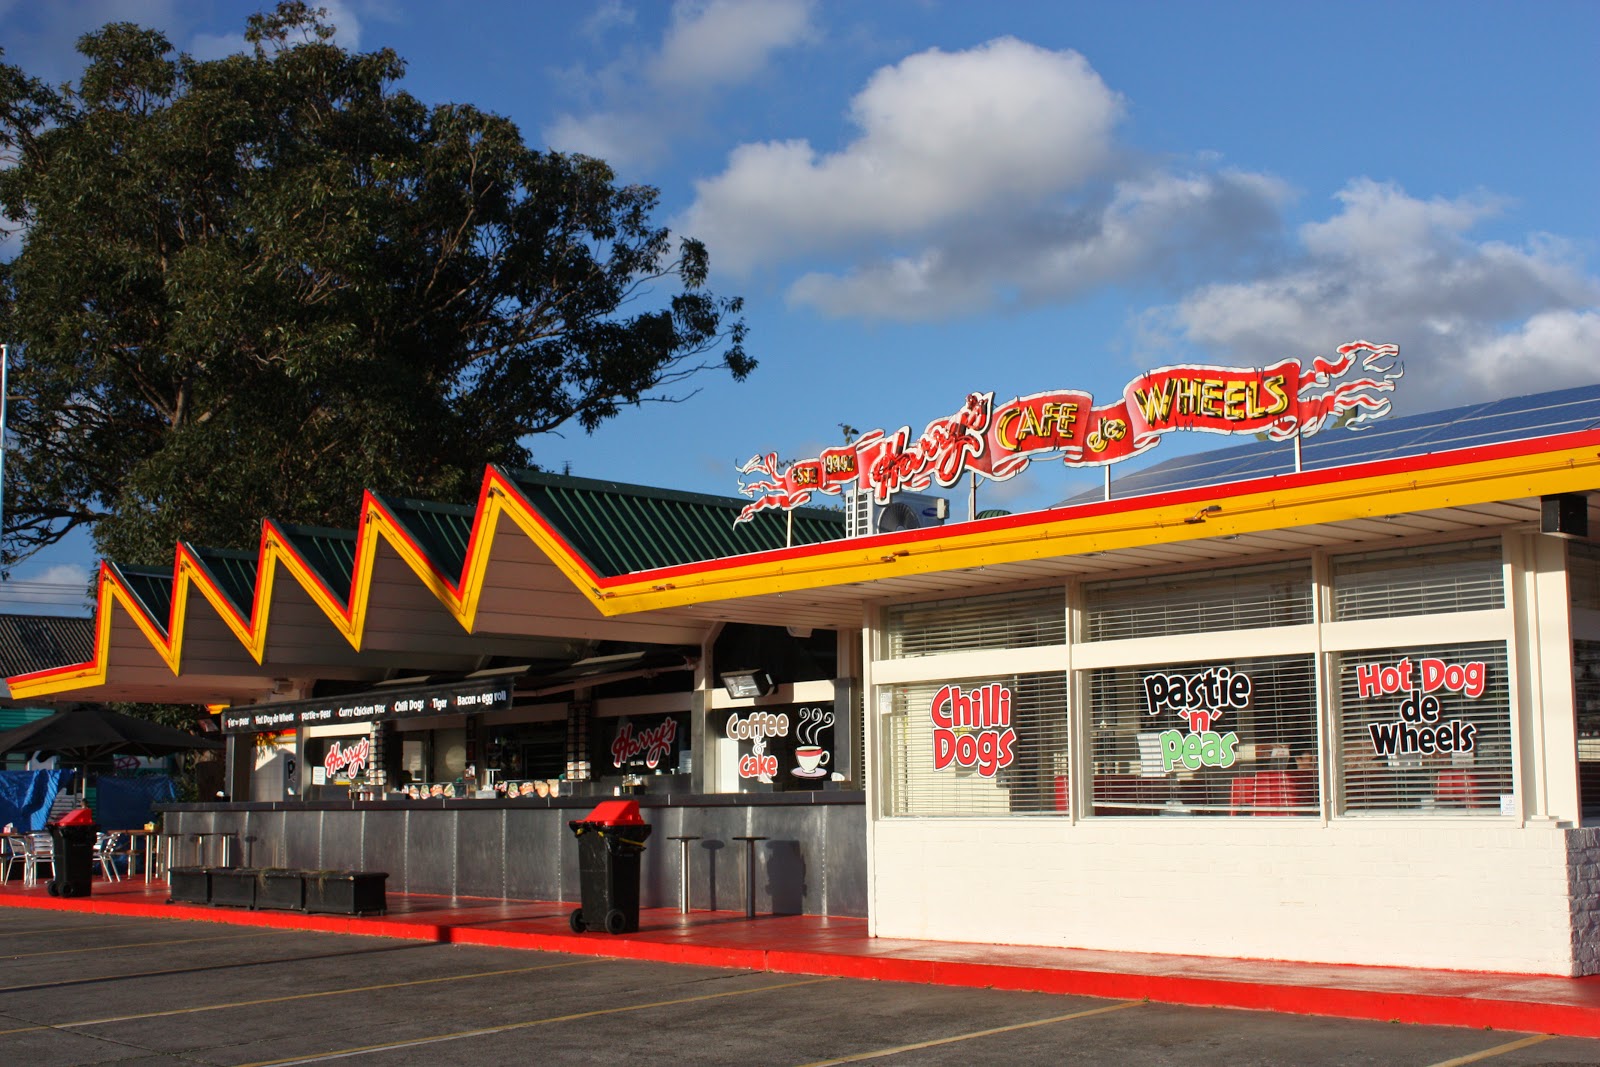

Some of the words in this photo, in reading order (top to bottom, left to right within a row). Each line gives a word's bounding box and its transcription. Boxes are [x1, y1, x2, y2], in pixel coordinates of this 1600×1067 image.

[871, 391, 993, 504] Harry's
[996, 402, 1078, 452] CAFE
[1086, 417, 1127, 453] de
[1133, 374, 1290, 426] WHEELS
[456, 695, 476, 706] Bacon
[481, 693, 494, 705] egg
[494, 690, 507, 701] roll
[1144, 667, 1251, 715] pastie
[1356, 657, 1413, 698] Hot
[1420, 658, 1486, 698] Dog
[338, 707, 353, 717] Curry
[353, 705, 374, 717] Chicken
[394, 700, 409, 712] Chilli
[409, 699, 425, 711] Dogs
[432, 697, 448, 711] Tiger
[930, 684, 1011, 730] Chilli
[1400, 688, 1440, 724] de
[611, 716, 677, 769] Harry's
[726, 711, 790, 740] Coffee
[1368, 720, 1477, 756] Wheels
[324, 737, 370, 779] Harry's
[932, 727, 1017, 778] Dogs
[1159, 729, 1239, 772] peas
